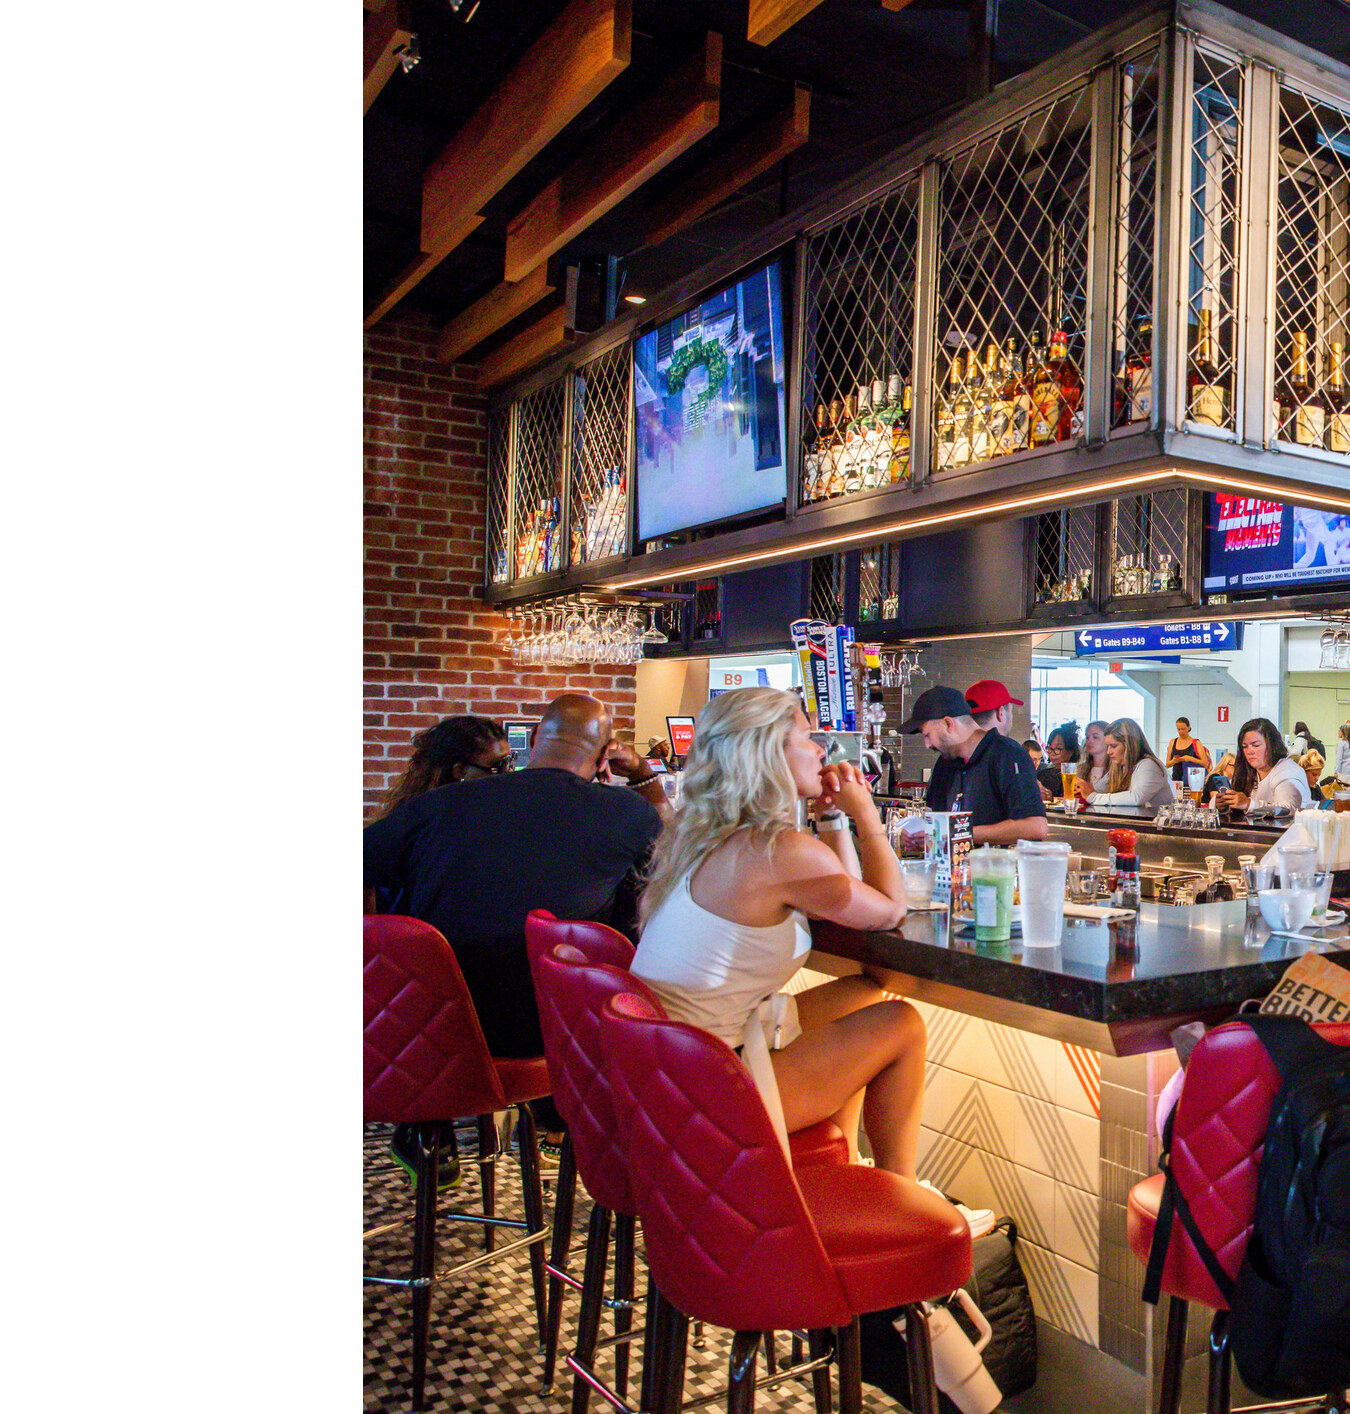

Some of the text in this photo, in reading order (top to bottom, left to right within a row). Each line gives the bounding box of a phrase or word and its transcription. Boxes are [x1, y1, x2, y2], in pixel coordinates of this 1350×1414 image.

[1225, 524, 1282, 552] MOMENTS
[1245, 574, 1264, 582] COMING
[827, 632, 836, 668] ULTRA
[1103, 637, 1146, 647] Gates B9-B49
[1160, 635, 1202, 645] Gates B1-B8
[724, 673, 743, 686] B9
[815, 660, 828, 693] BOSTON
[818, 695, 831, 723] LAGER
